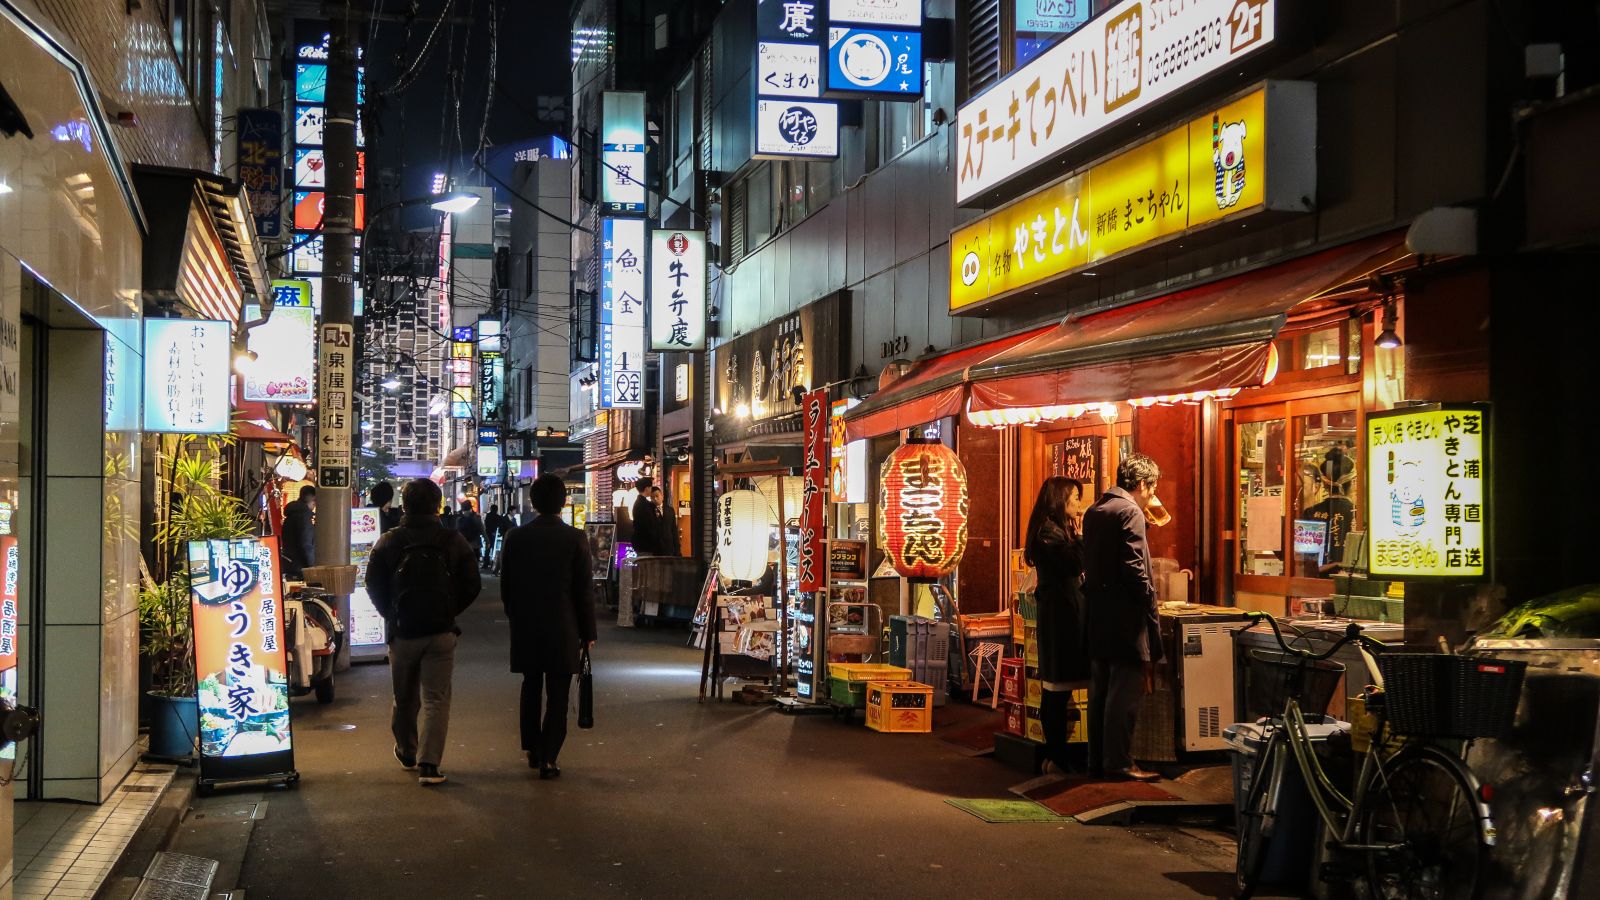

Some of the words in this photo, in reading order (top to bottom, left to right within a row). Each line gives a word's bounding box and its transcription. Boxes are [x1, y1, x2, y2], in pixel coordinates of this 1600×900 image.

[1232, 1, 1262, 49] 2F
[614, 144, 636, 153] 4F
[611, 203, 636, 211] 3F
[993, 250, 1012, 279] 名物
[1013, 197, 1088, 270] やきとん
[1095, 207, 1118, 238] 新橋
[1123, 179, 1184, 231] まこちゃん
[615, 248, 643, 315] 魚金
[328, 353, 346, 429] 泉屋質店
[800, 399, 820, 584] ランチサービス
[1443, 413, 1462, 569] やきとん専門店
[1462, 414, 1482, 568] 芝浦直送
[221, 561, 260, 721] ゆうき家
[261, 598, 278, 651] 居酒屋
